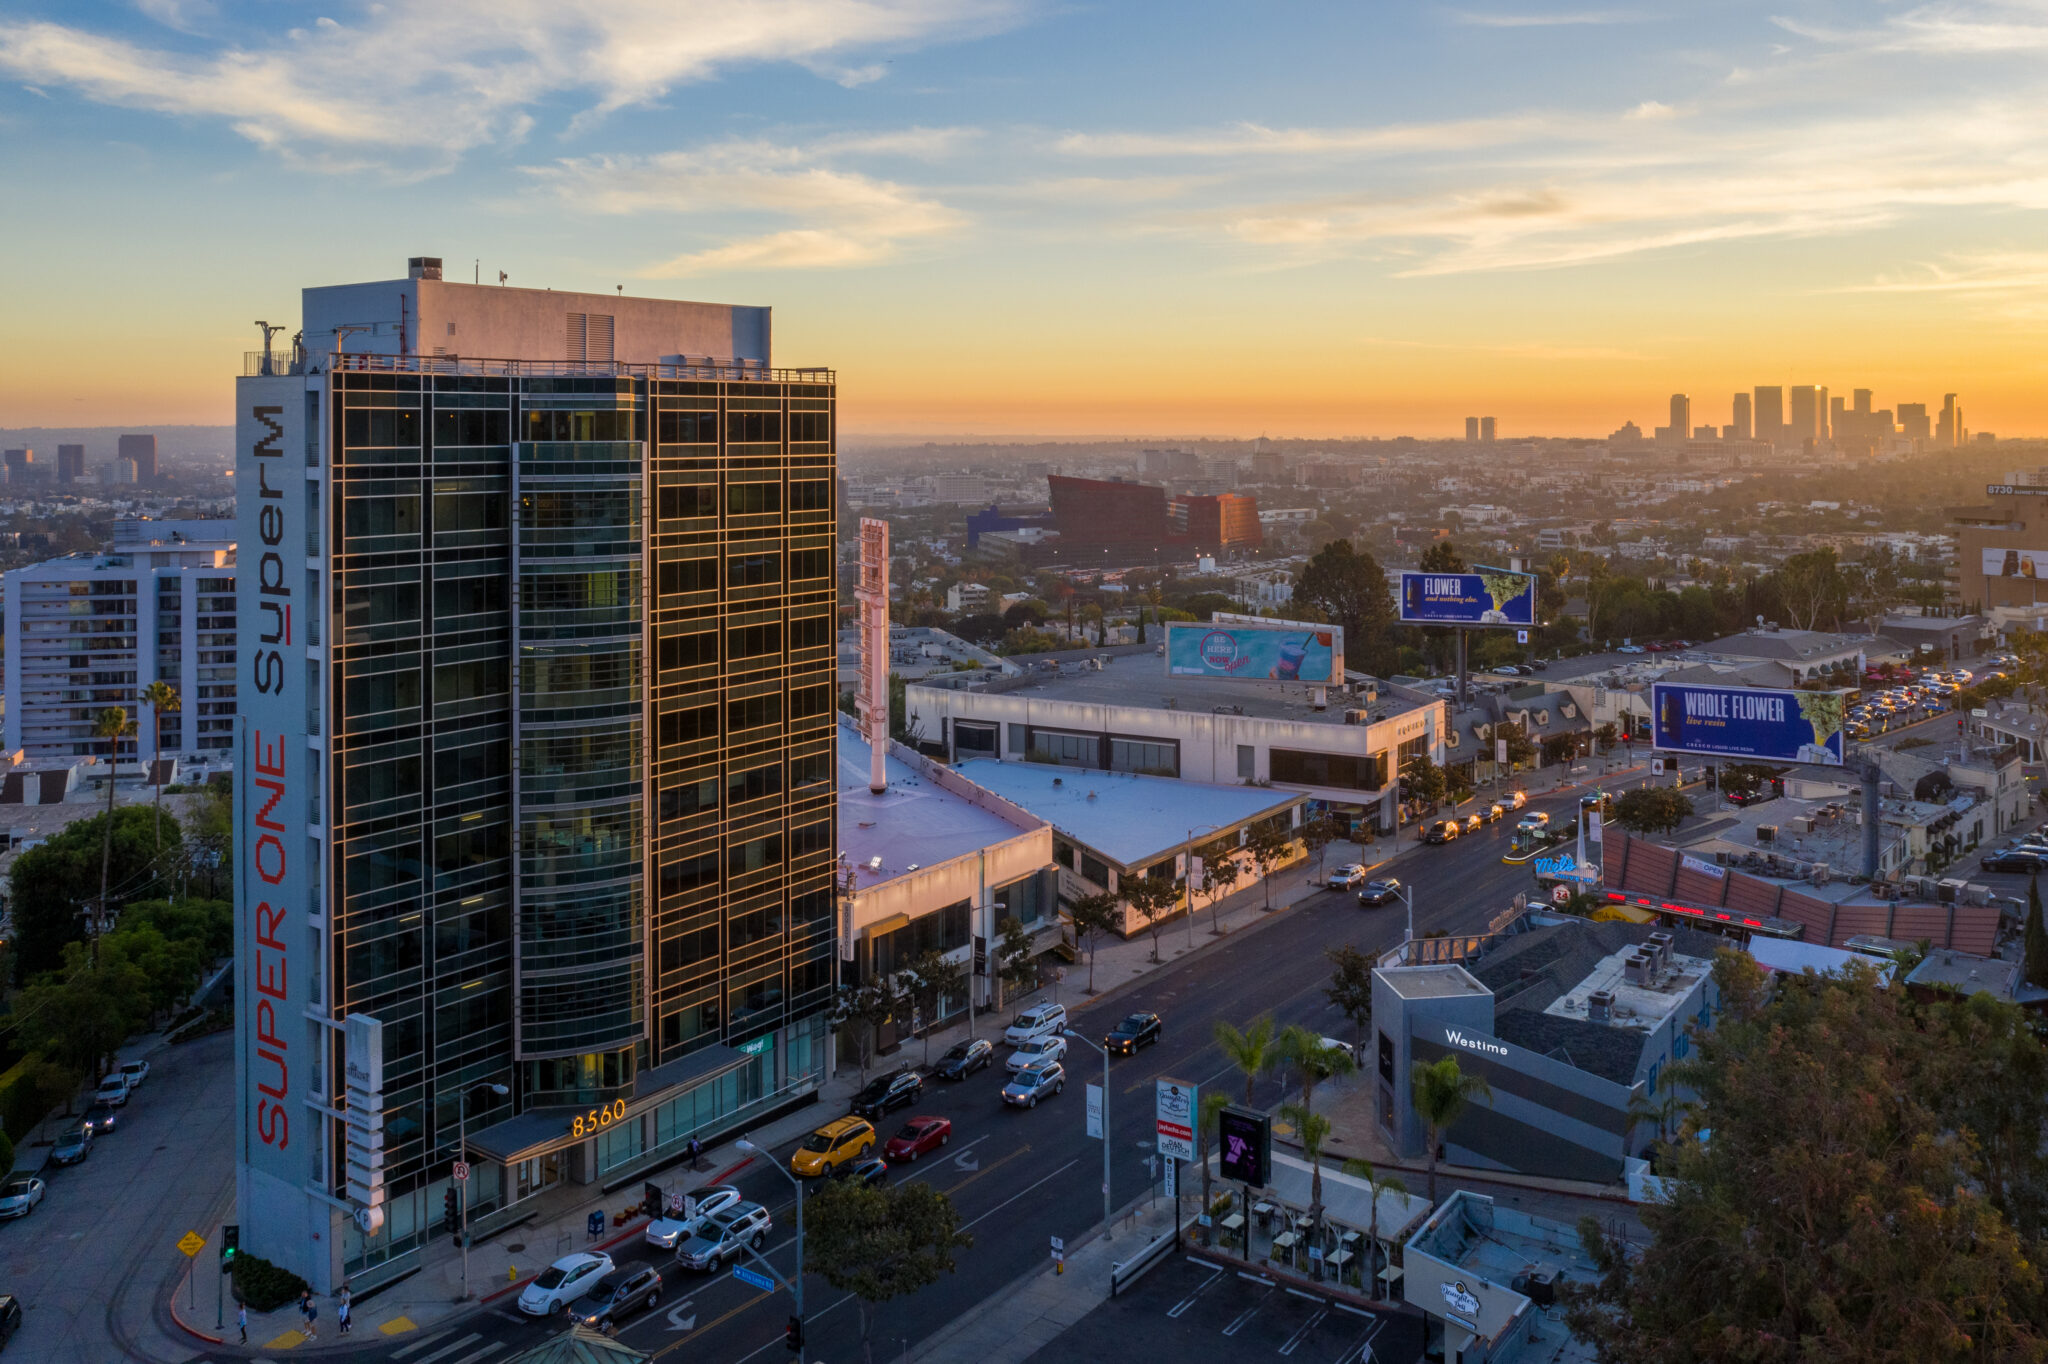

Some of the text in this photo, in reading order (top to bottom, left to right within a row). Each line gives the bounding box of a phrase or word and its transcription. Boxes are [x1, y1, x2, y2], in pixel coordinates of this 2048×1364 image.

[1988, 485, 2013, 494] 8730
[253, 406, 290, 696] SuperM
[1424, 578, 1461, 596] FLOWER
[1207, 646, 1232, 654] HERE
[1209, 656, 1230, 664] NOW
[1684, 692, 1785, 722] WHOLE FLOWER
[1686, 716, 1726, 728] live resin
[1704, 864, 1723, 875] OPEN
[1556, 891, 1568, 899] 24
[256, 730, 288, 1151] SUPER ONE
[1445, 1028, 1508, 1056] Westime
[573, 1098, 625, 1138] 8560
[1162, 1142, 1190, 1154] DEUTSCH
[1168, 1140, 1182, 1148] DAN
